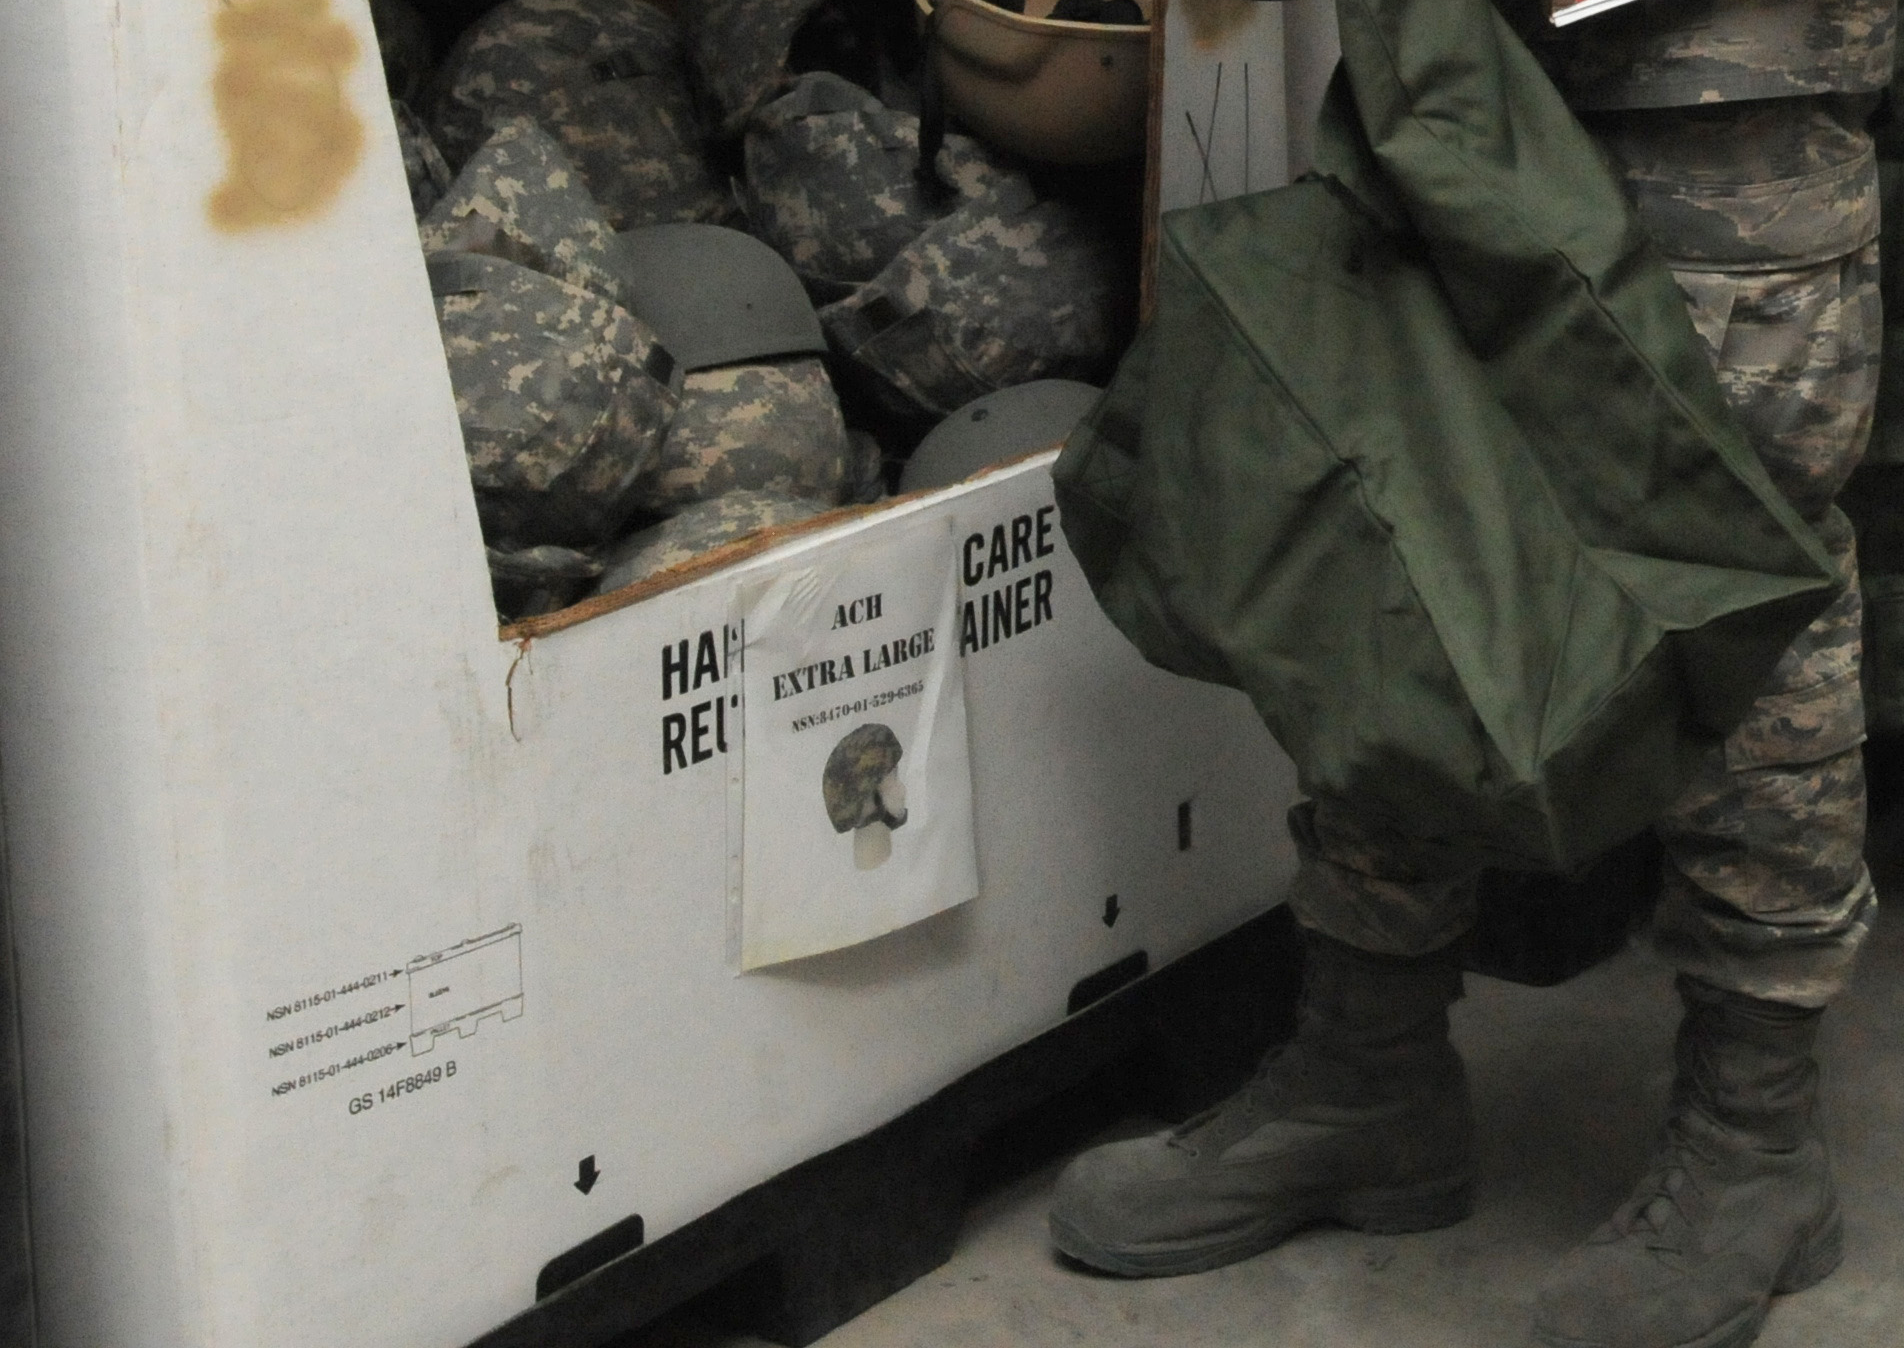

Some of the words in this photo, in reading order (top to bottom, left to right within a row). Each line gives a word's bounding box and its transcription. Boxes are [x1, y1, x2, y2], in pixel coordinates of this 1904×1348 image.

[963, 505, 1054, 586] CARE
[831, 593, 882, 630] ACH
[772, 654, 856, 701] EXTRA
[863, 627, 935, 674] LARGE
[266, 1004, 292, 1022] NSN
[293, 970, 389, 1013] 8115-01-444-0211
[269, 1041, 295, 1059] NSN
[296, 1005, 391, 1050] 8115-01-444-0212
[271, 1078, 297, 1097] NSN
[348, 1092, 374, 1115] GS
[378, 1065, 443, 1104] 14F8849
[446, 1059, 458, 1079] B
